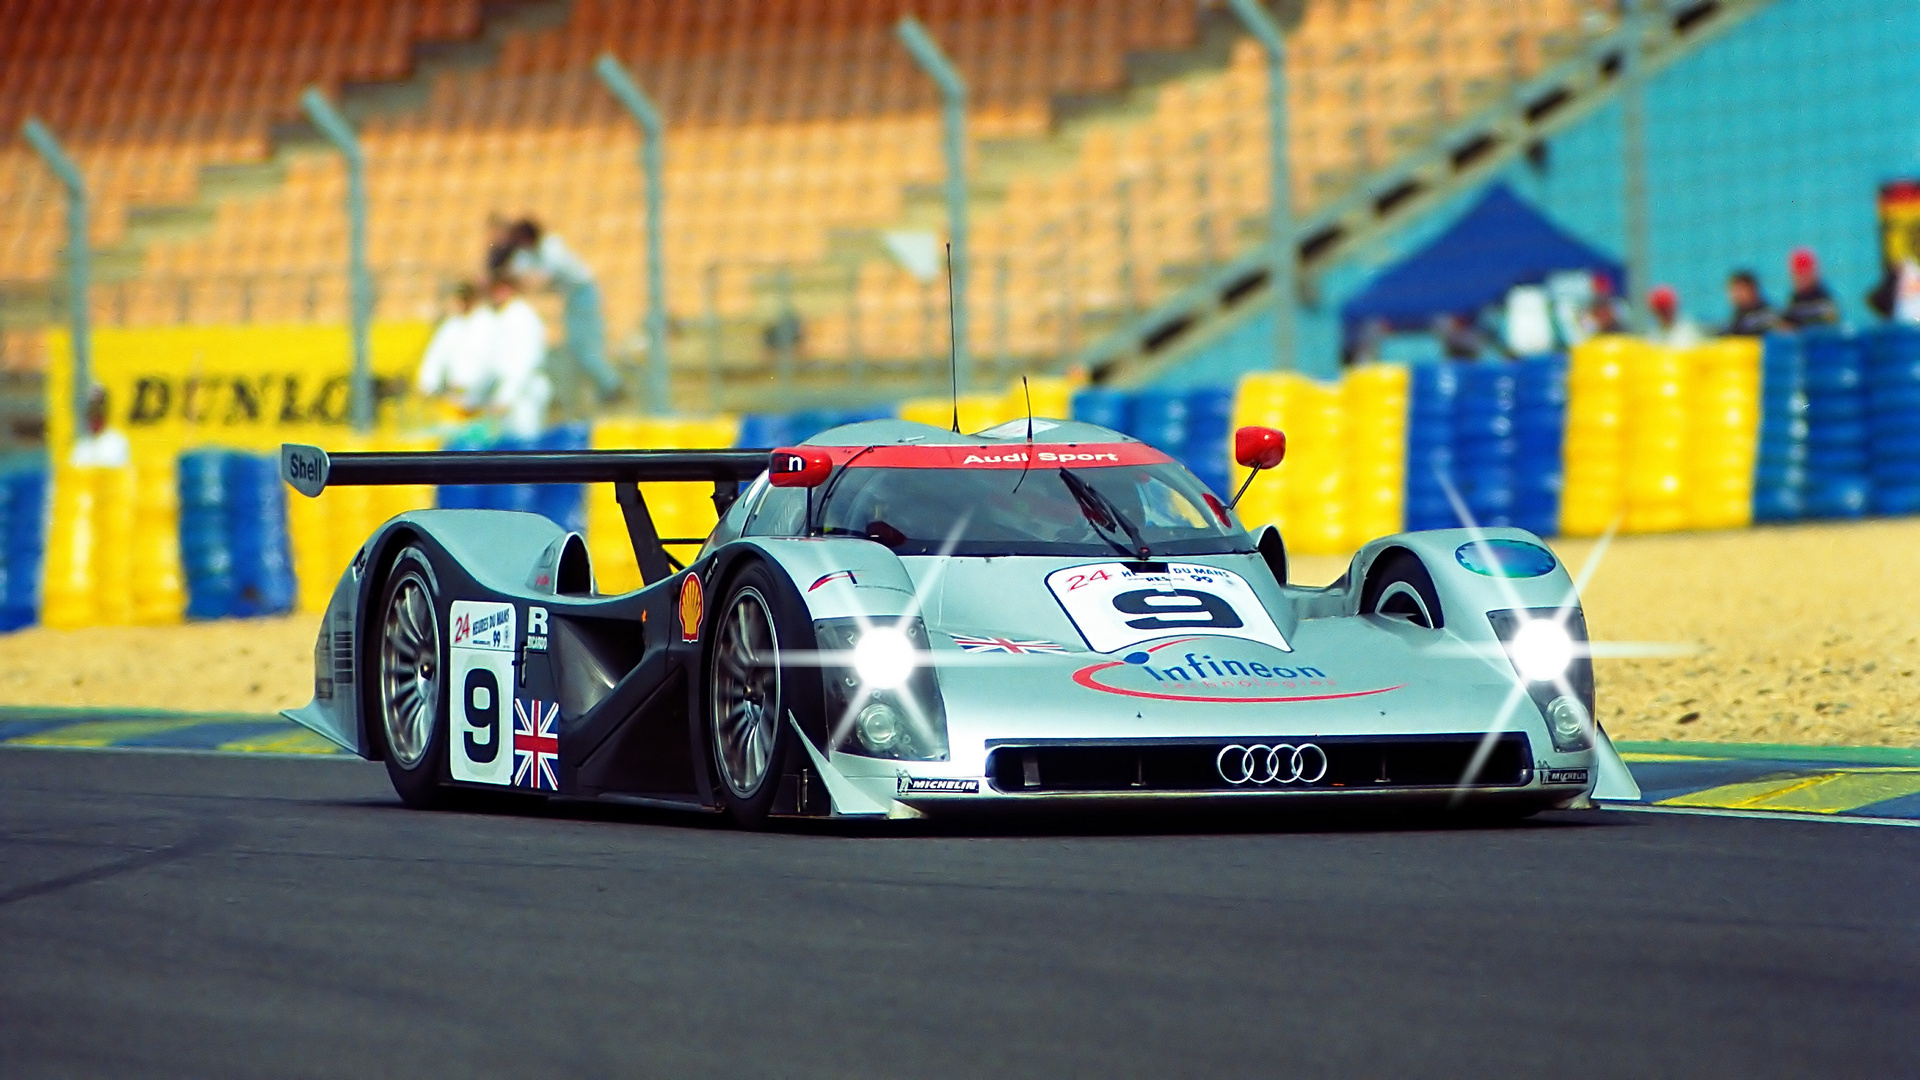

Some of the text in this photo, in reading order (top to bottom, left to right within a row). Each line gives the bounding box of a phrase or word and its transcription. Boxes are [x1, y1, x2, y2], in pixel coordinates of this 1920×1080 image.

[290, 452, 322, 483] Shell
[963, 451, 1119, 464] Audi Sport
[1065, 568, 1113, 592] 24
[1194, 567, 1231, 578] MANS
[1190, 574, 1214, 584] 99
[527, 606, 549, 635] R
[1112, 588, 1244, 630] 9
[455, 612, 471, 643] 24
[492, 630, 501, 648] 99
[463, 668, 500, 763] 9
[912, 780, 978, 791] MICHELIN
[1551, 772, 1588, 780] MICHELIN
